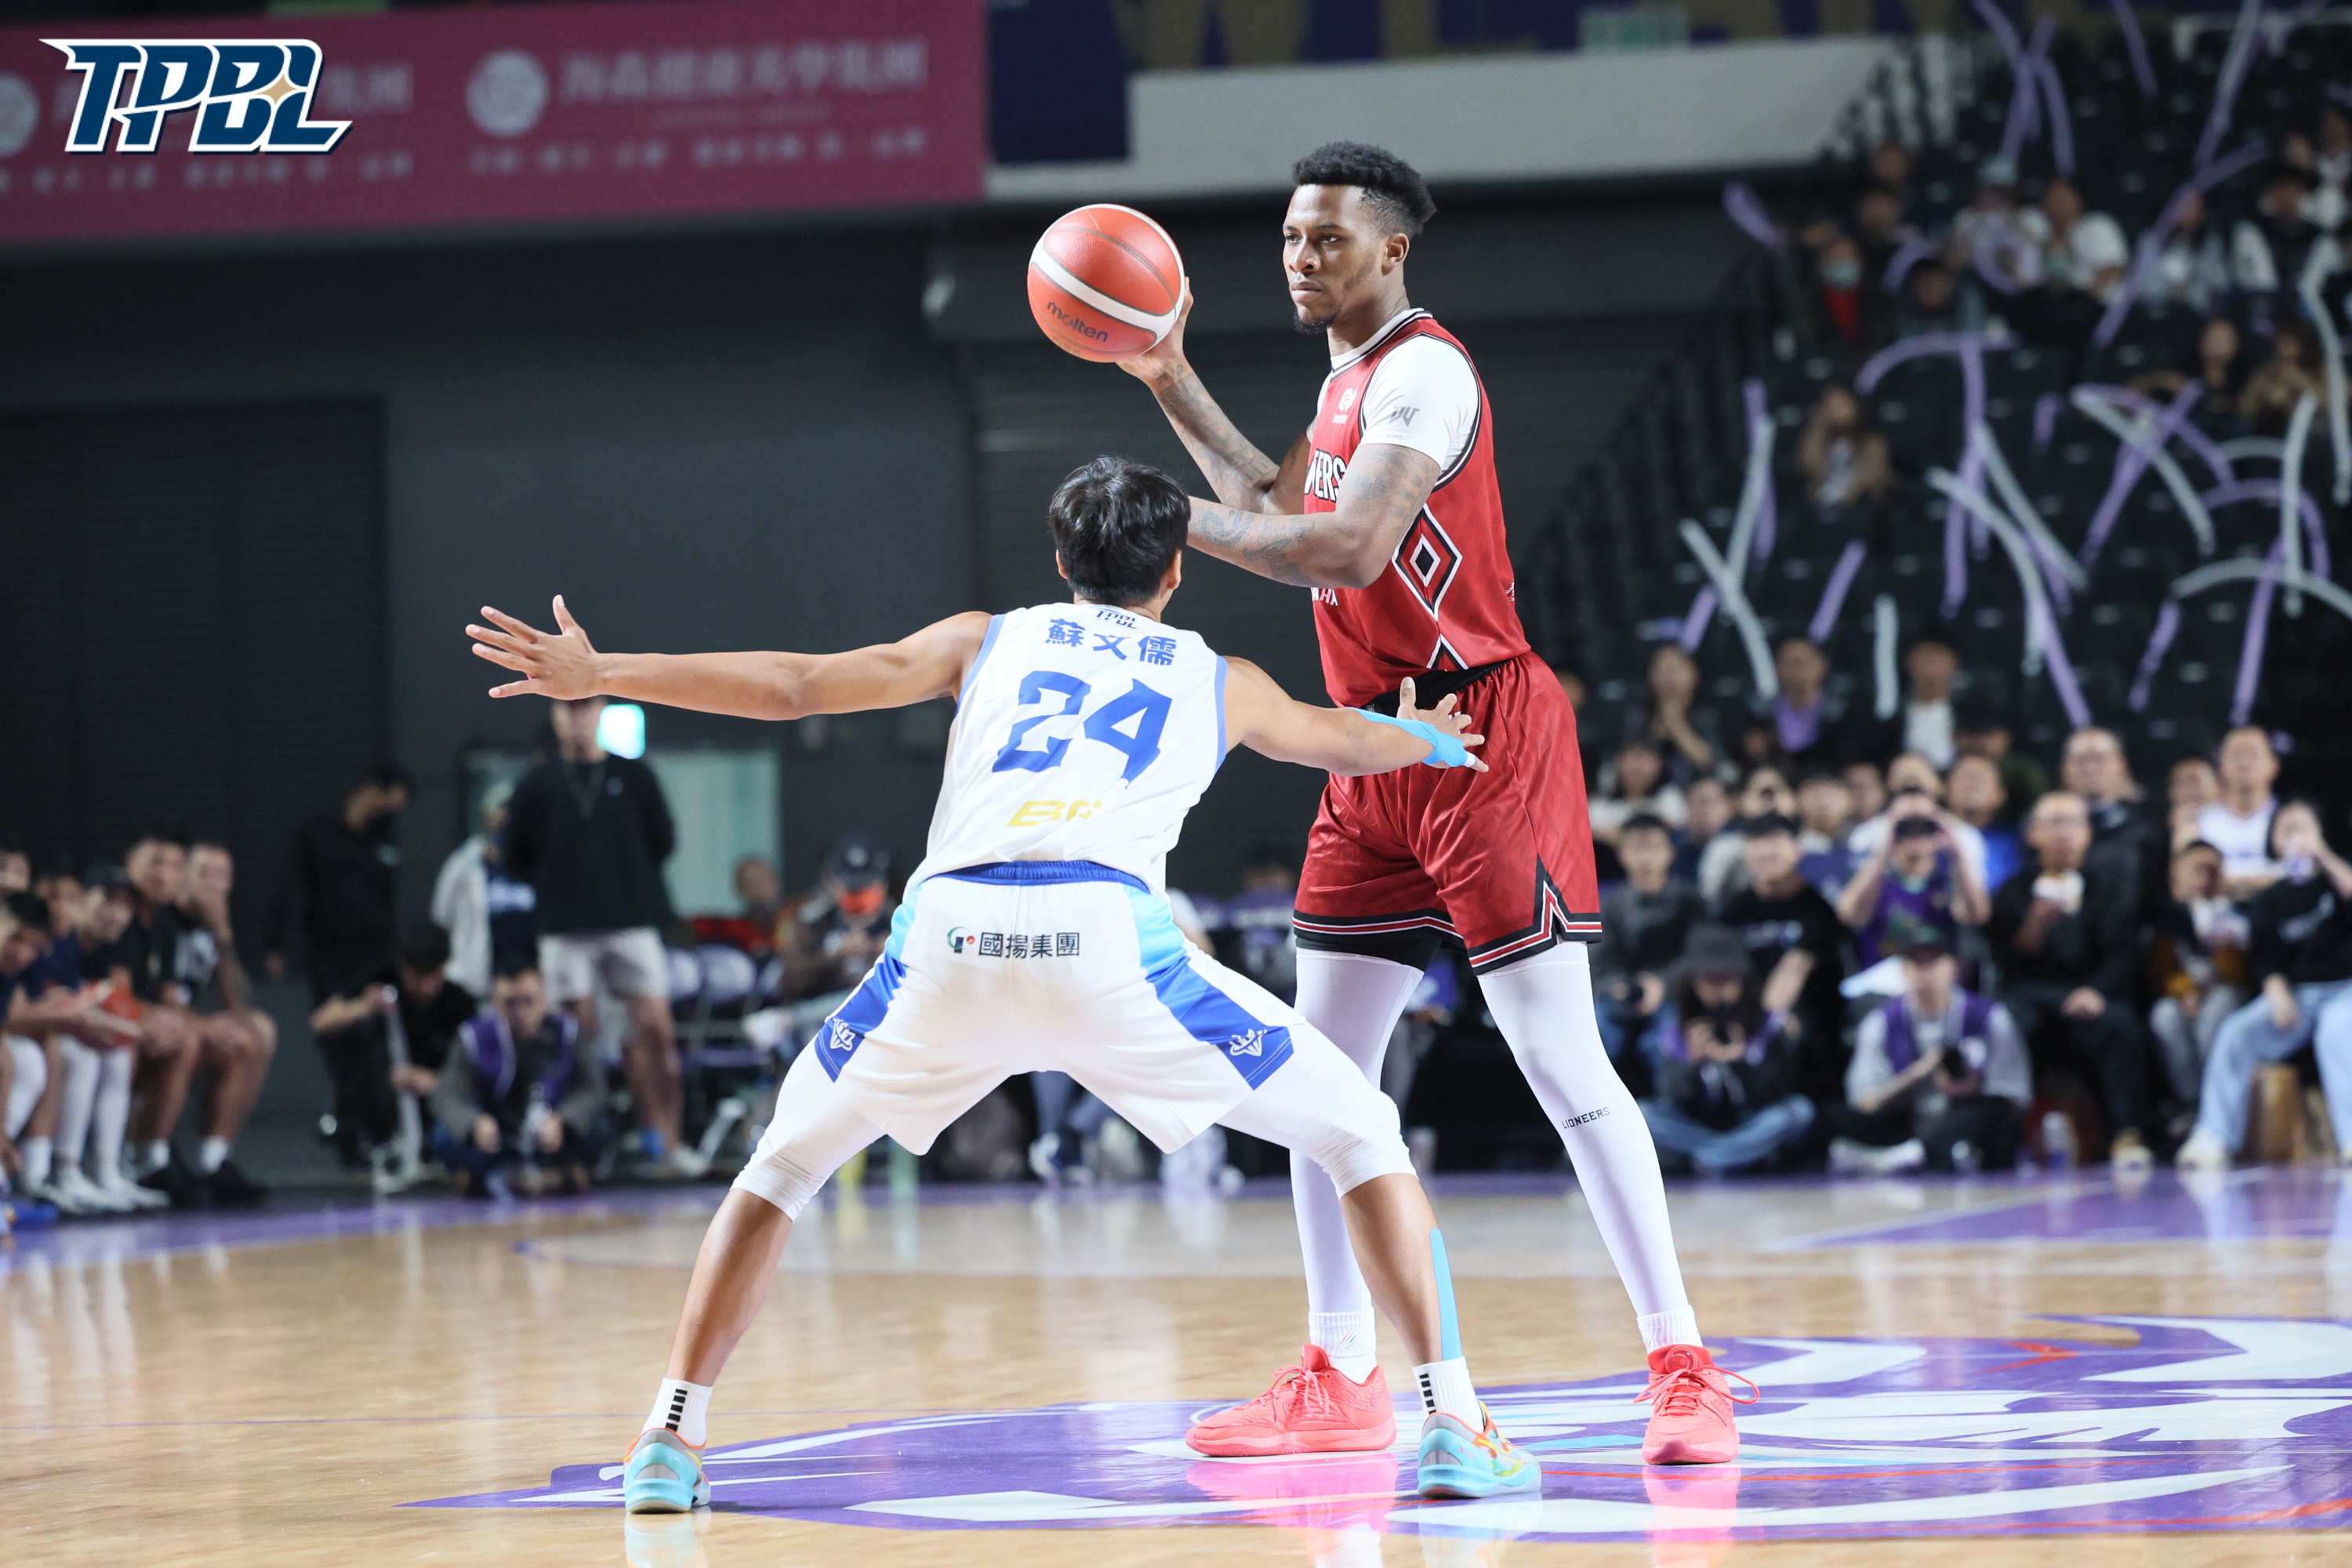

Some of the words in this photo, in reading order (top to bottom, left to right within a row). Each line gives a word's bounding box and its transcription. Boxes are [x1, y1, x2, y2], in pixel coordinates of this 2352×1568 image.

[1047, 301, 1108, 342] molten
[1096, 609, 1138, 630] TPBL
[1044, 618, 1177, 666] 蘇文儒
[992, 670, 1172, 789] 24
[978, 932, 1080, 959] 國揚集團
[1561, 1107, 1610, 1129] LIONEERS
